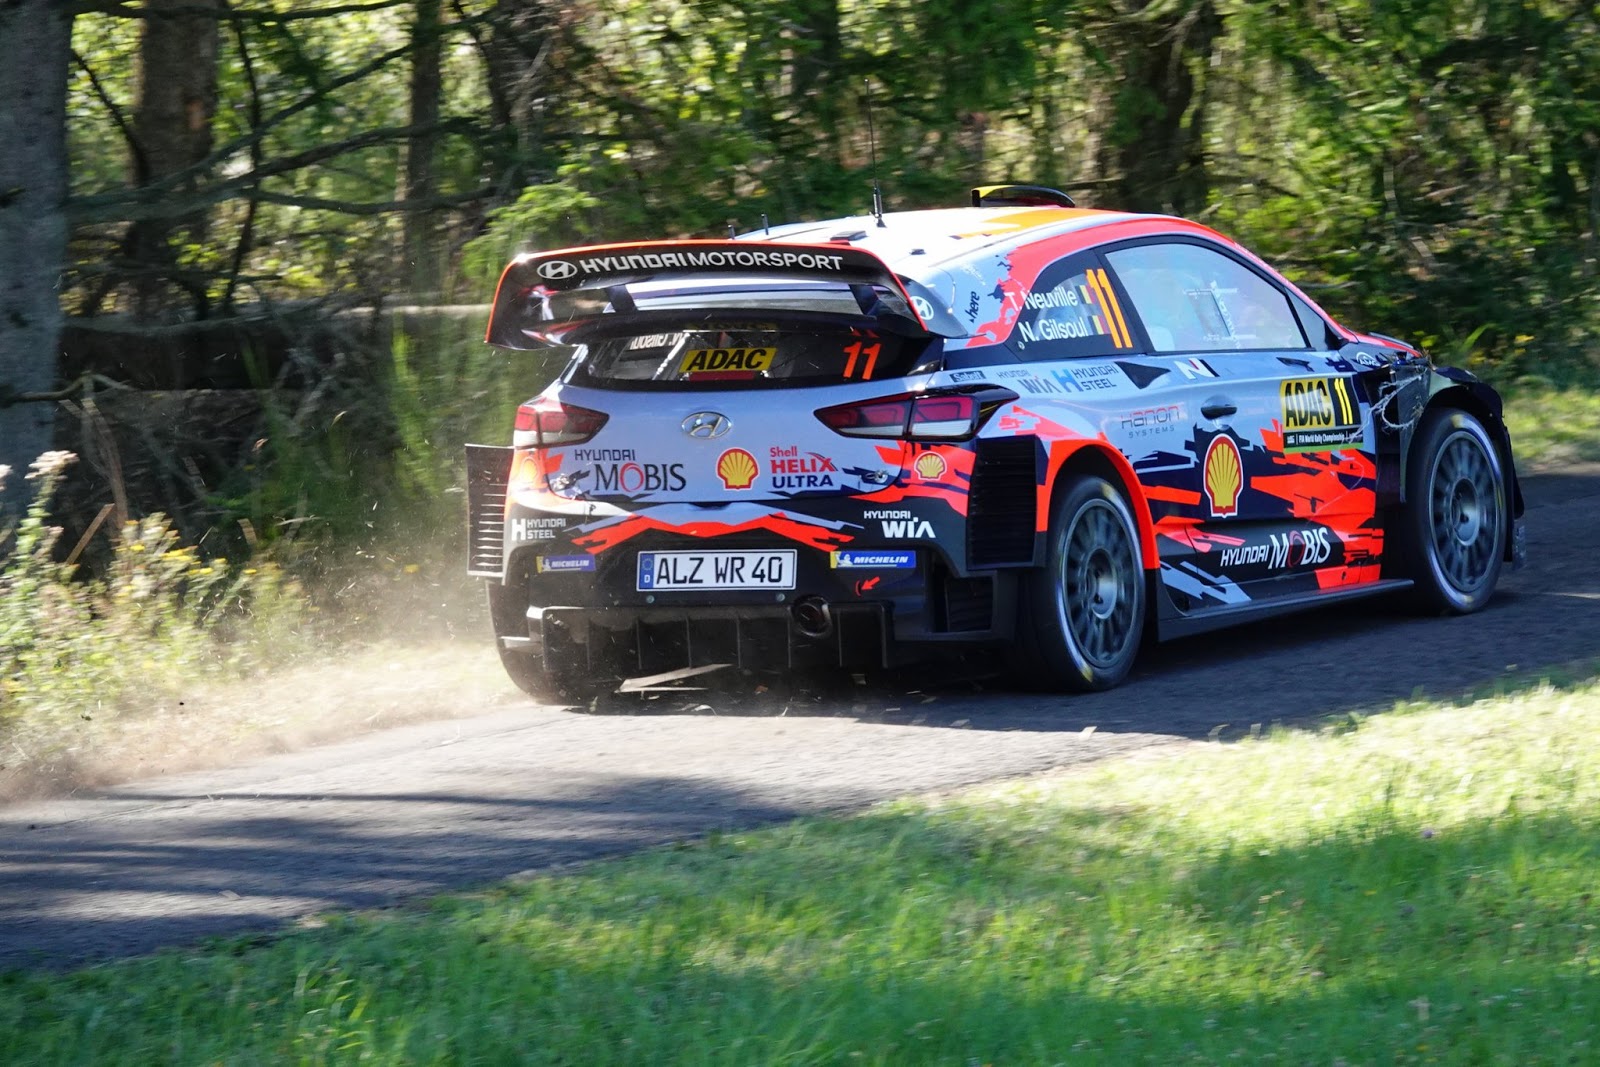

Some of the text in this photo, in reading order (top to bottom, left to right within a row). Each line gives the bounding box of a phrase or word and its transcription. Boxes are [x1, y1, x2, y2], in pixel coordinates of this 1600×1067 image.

[580, 251, 843, 274] HYUNDAI MOTORSPORT
[965, 291, 980, 319] here
[1004, 286, 1078, 311] T. Neuville
[1086, 268, 1133, 348] 11
[1018, 317, 1088, 342] N. Gilsoul
[686, 349, 767, 371] ADAC
[843, 341, 881, 380] 11
[1071, 364, 1119, 379] HYUNDAI
[1080, 378, 1117, 390] STEEL
[1285, 380, 1332, 427] ADAC
[1334, 377, 1353, 425] 11
[1128, 425, 1175, 439] SYSTEMS
[574, 448, 636, 461] HYUNDAI
[769, 446, 798, 458] Shell
[770, 453, 838, 474] HELIX
[594, 462, 687, 491] MOBIS
[772, 474, 834, 488] ULTRA
[526, 518, 567, 528] HYUNDAI
[863, 510, 911, 520] HYUNDAI
[526, 529, 556, 539] STEEL
[1220, 544, 1269, 567] HYUNDAI
[1267, 526, 1332, 570] MOBIS
[551, 560, 590, 568] MICHELIN
[655, 556, 783, 585] ALZ WR 40
[852, 555, 909, 564] MICHELIN
